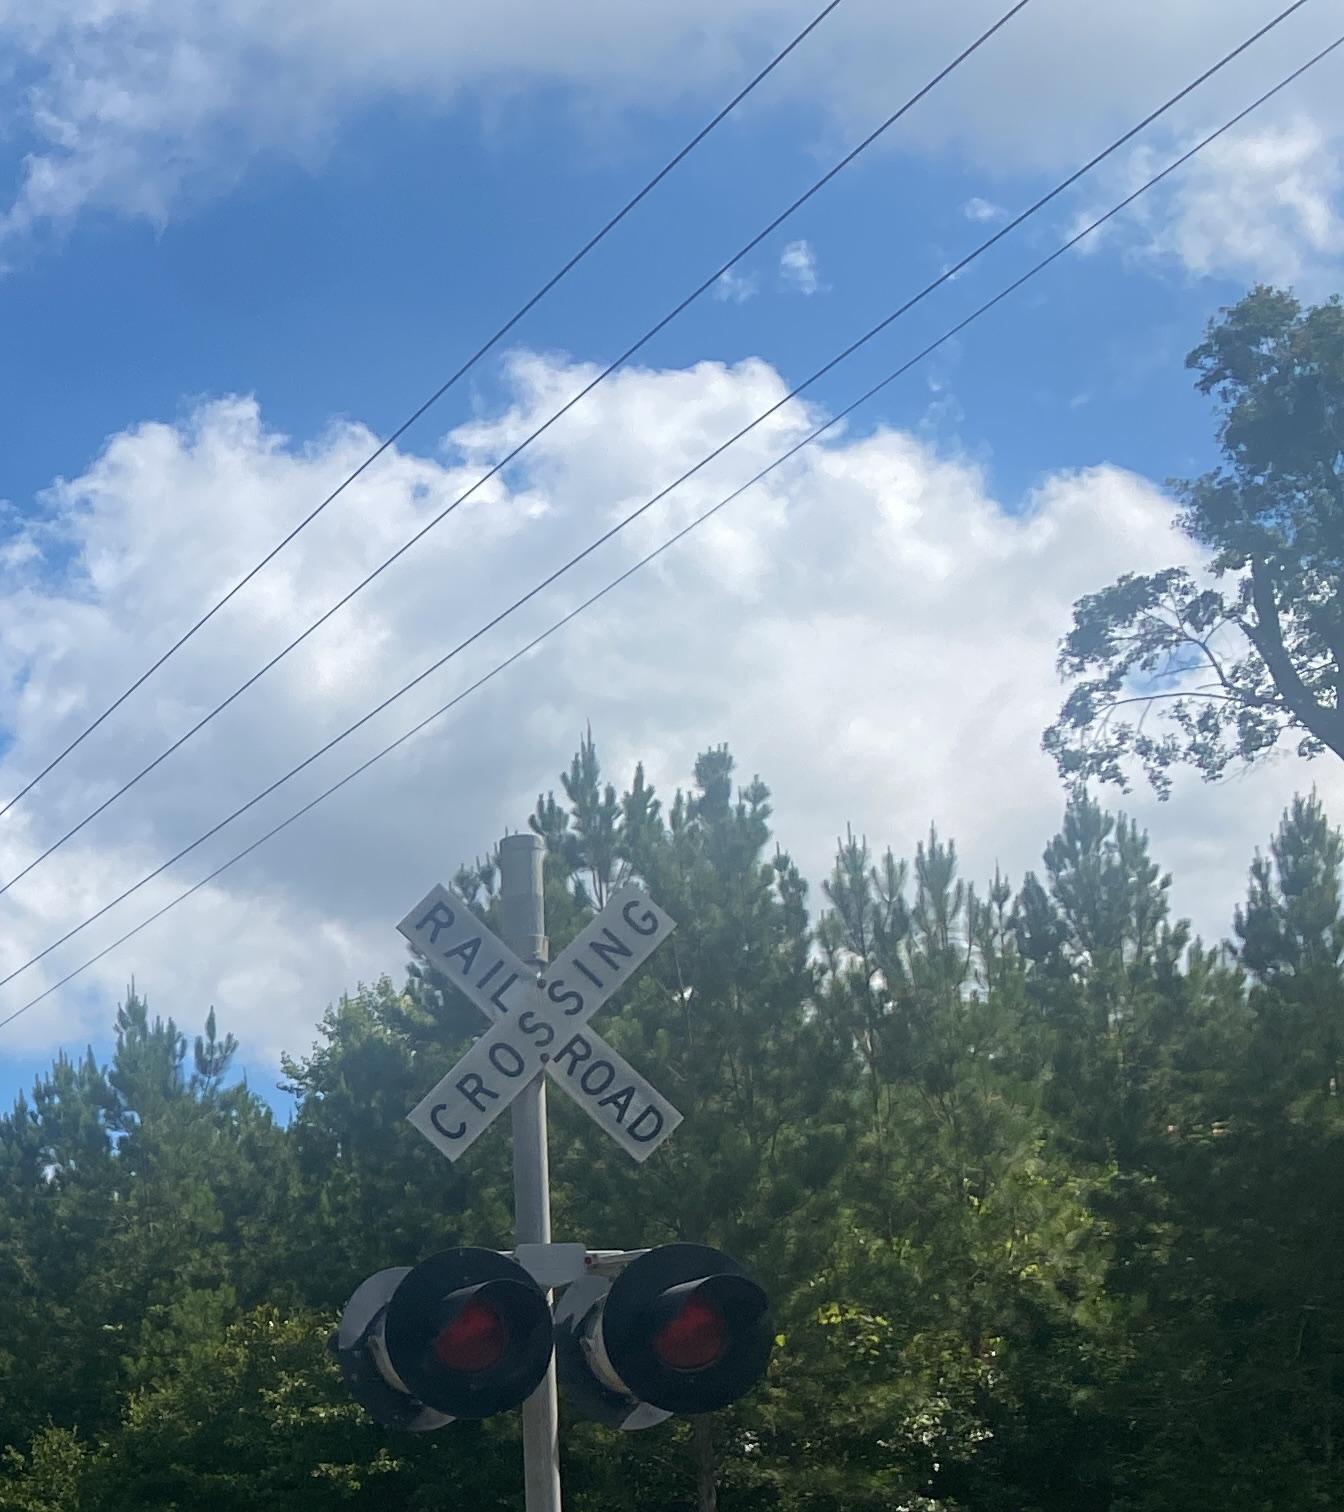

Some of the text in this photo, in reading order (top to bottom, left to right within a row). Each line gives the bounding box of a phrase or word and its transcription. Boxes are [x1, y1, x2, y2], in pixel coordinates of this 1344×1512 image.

[414, 900, 664, 1142] RAIL ROAD
[430, 900, 659, 1140] CROSSING
